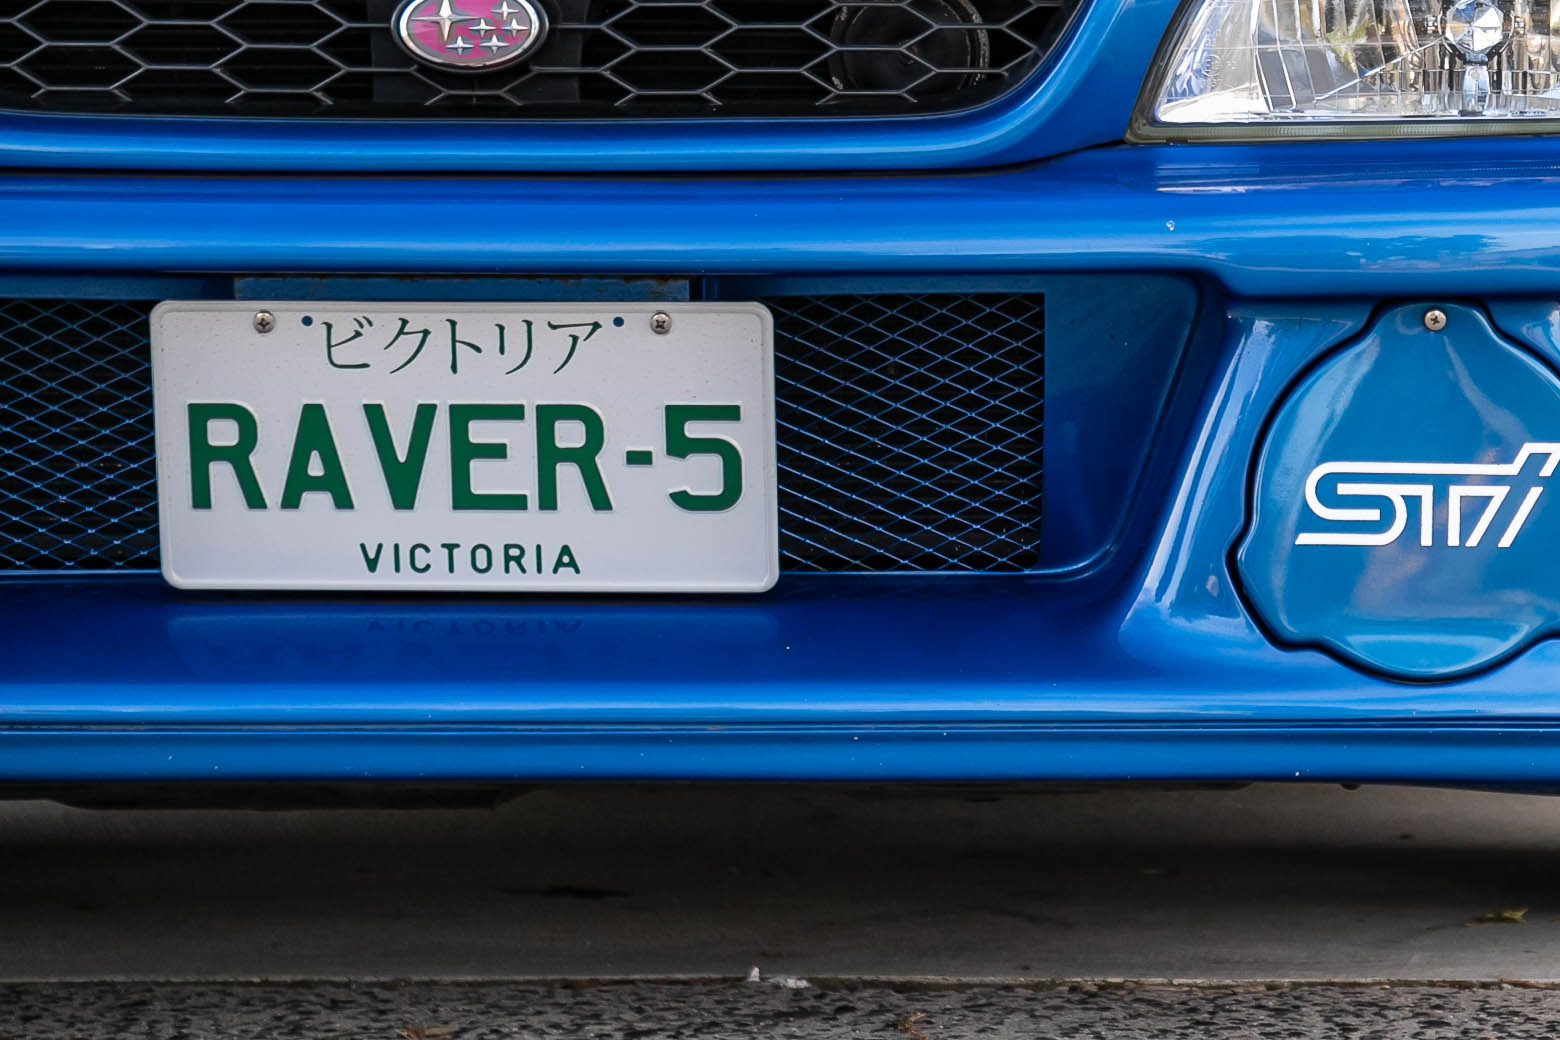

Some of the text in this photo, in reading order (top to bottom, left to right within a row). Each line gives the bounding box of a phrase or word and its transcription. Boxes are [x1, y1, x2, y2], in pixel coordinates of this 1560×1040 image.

[322, 315, 602, 375] ビクトリア
[186, 402, 744, 511] RAVER-5
[359, 542, 581, 575] VICTORIA
